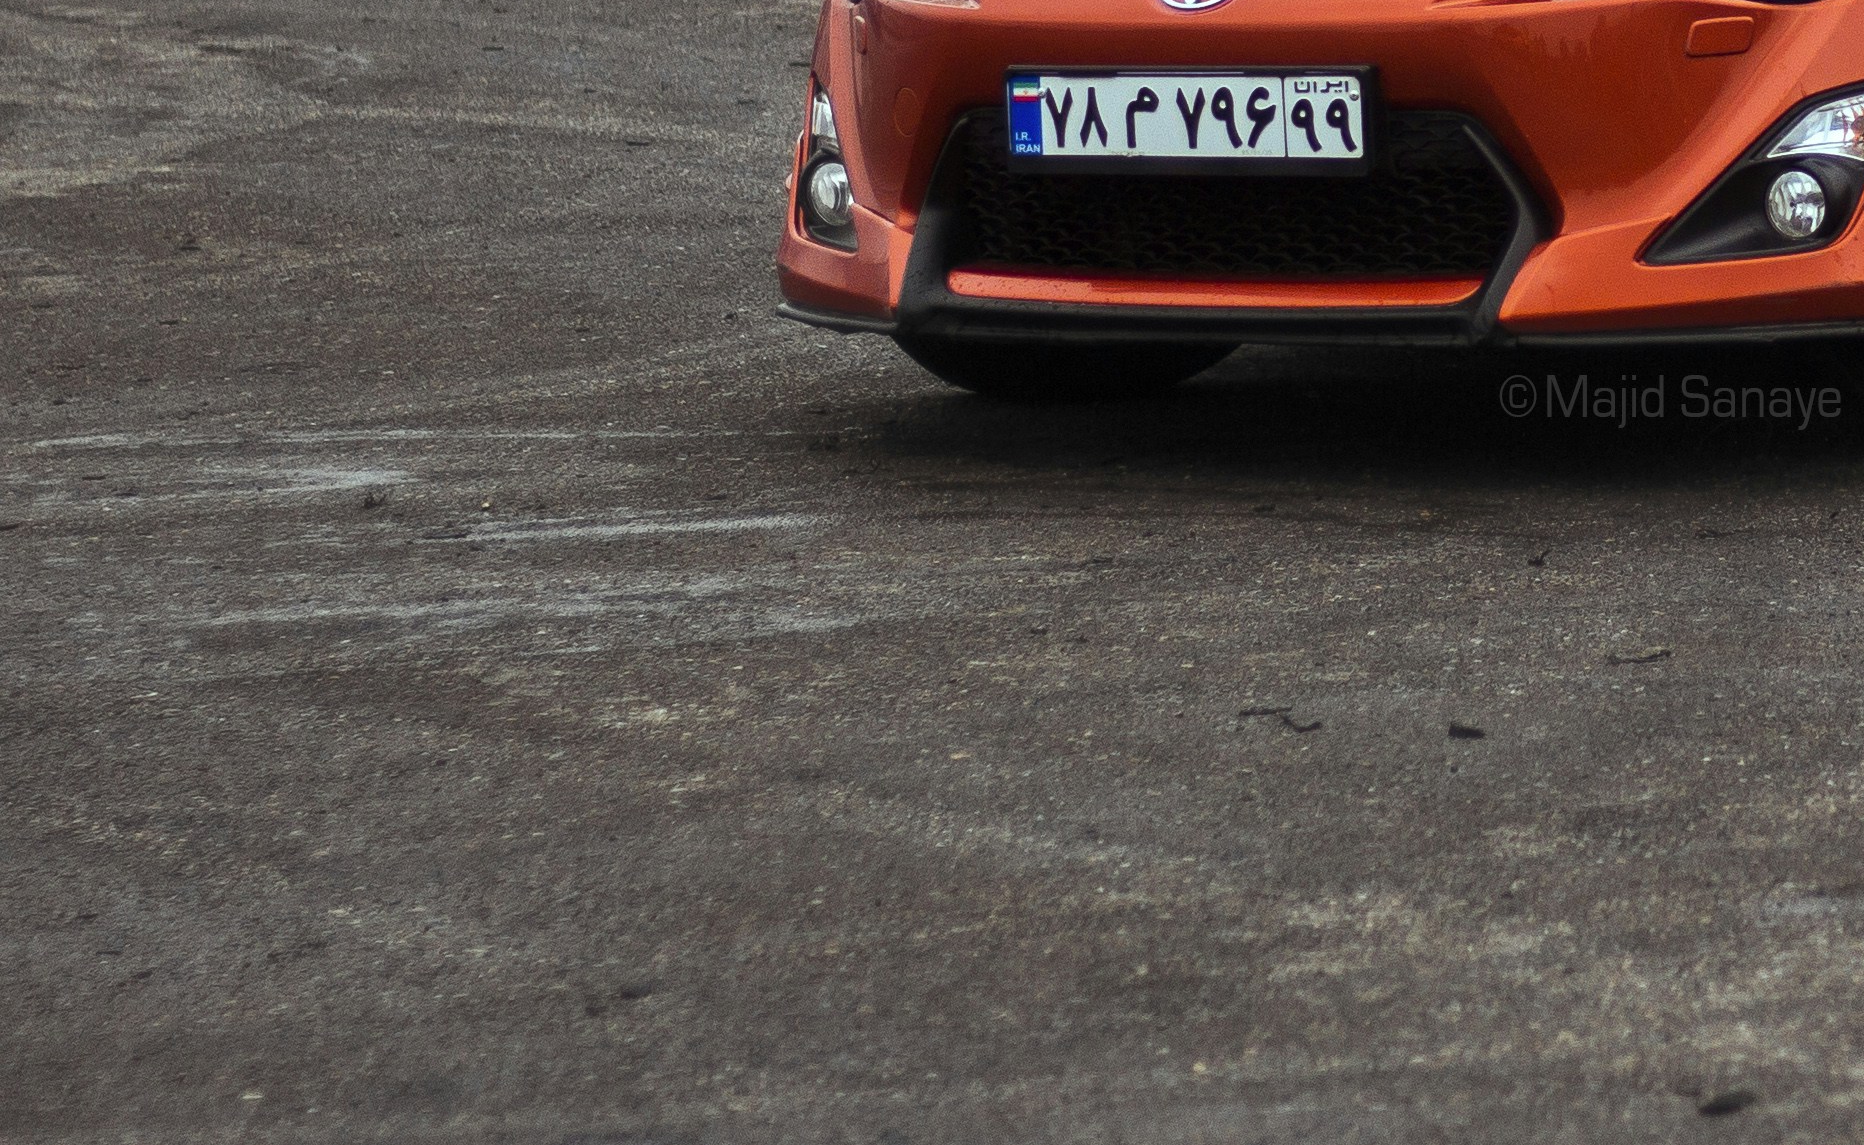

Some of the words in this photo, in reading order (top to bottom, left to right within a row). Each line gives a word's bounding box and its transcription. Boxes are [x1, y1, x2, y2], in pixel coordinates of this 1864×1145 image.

[1293, 80, 1349, 94] ایران
[1290, 98, 1359, 153] ۹۹
[1015, 143, 1042, 154] IRAN
